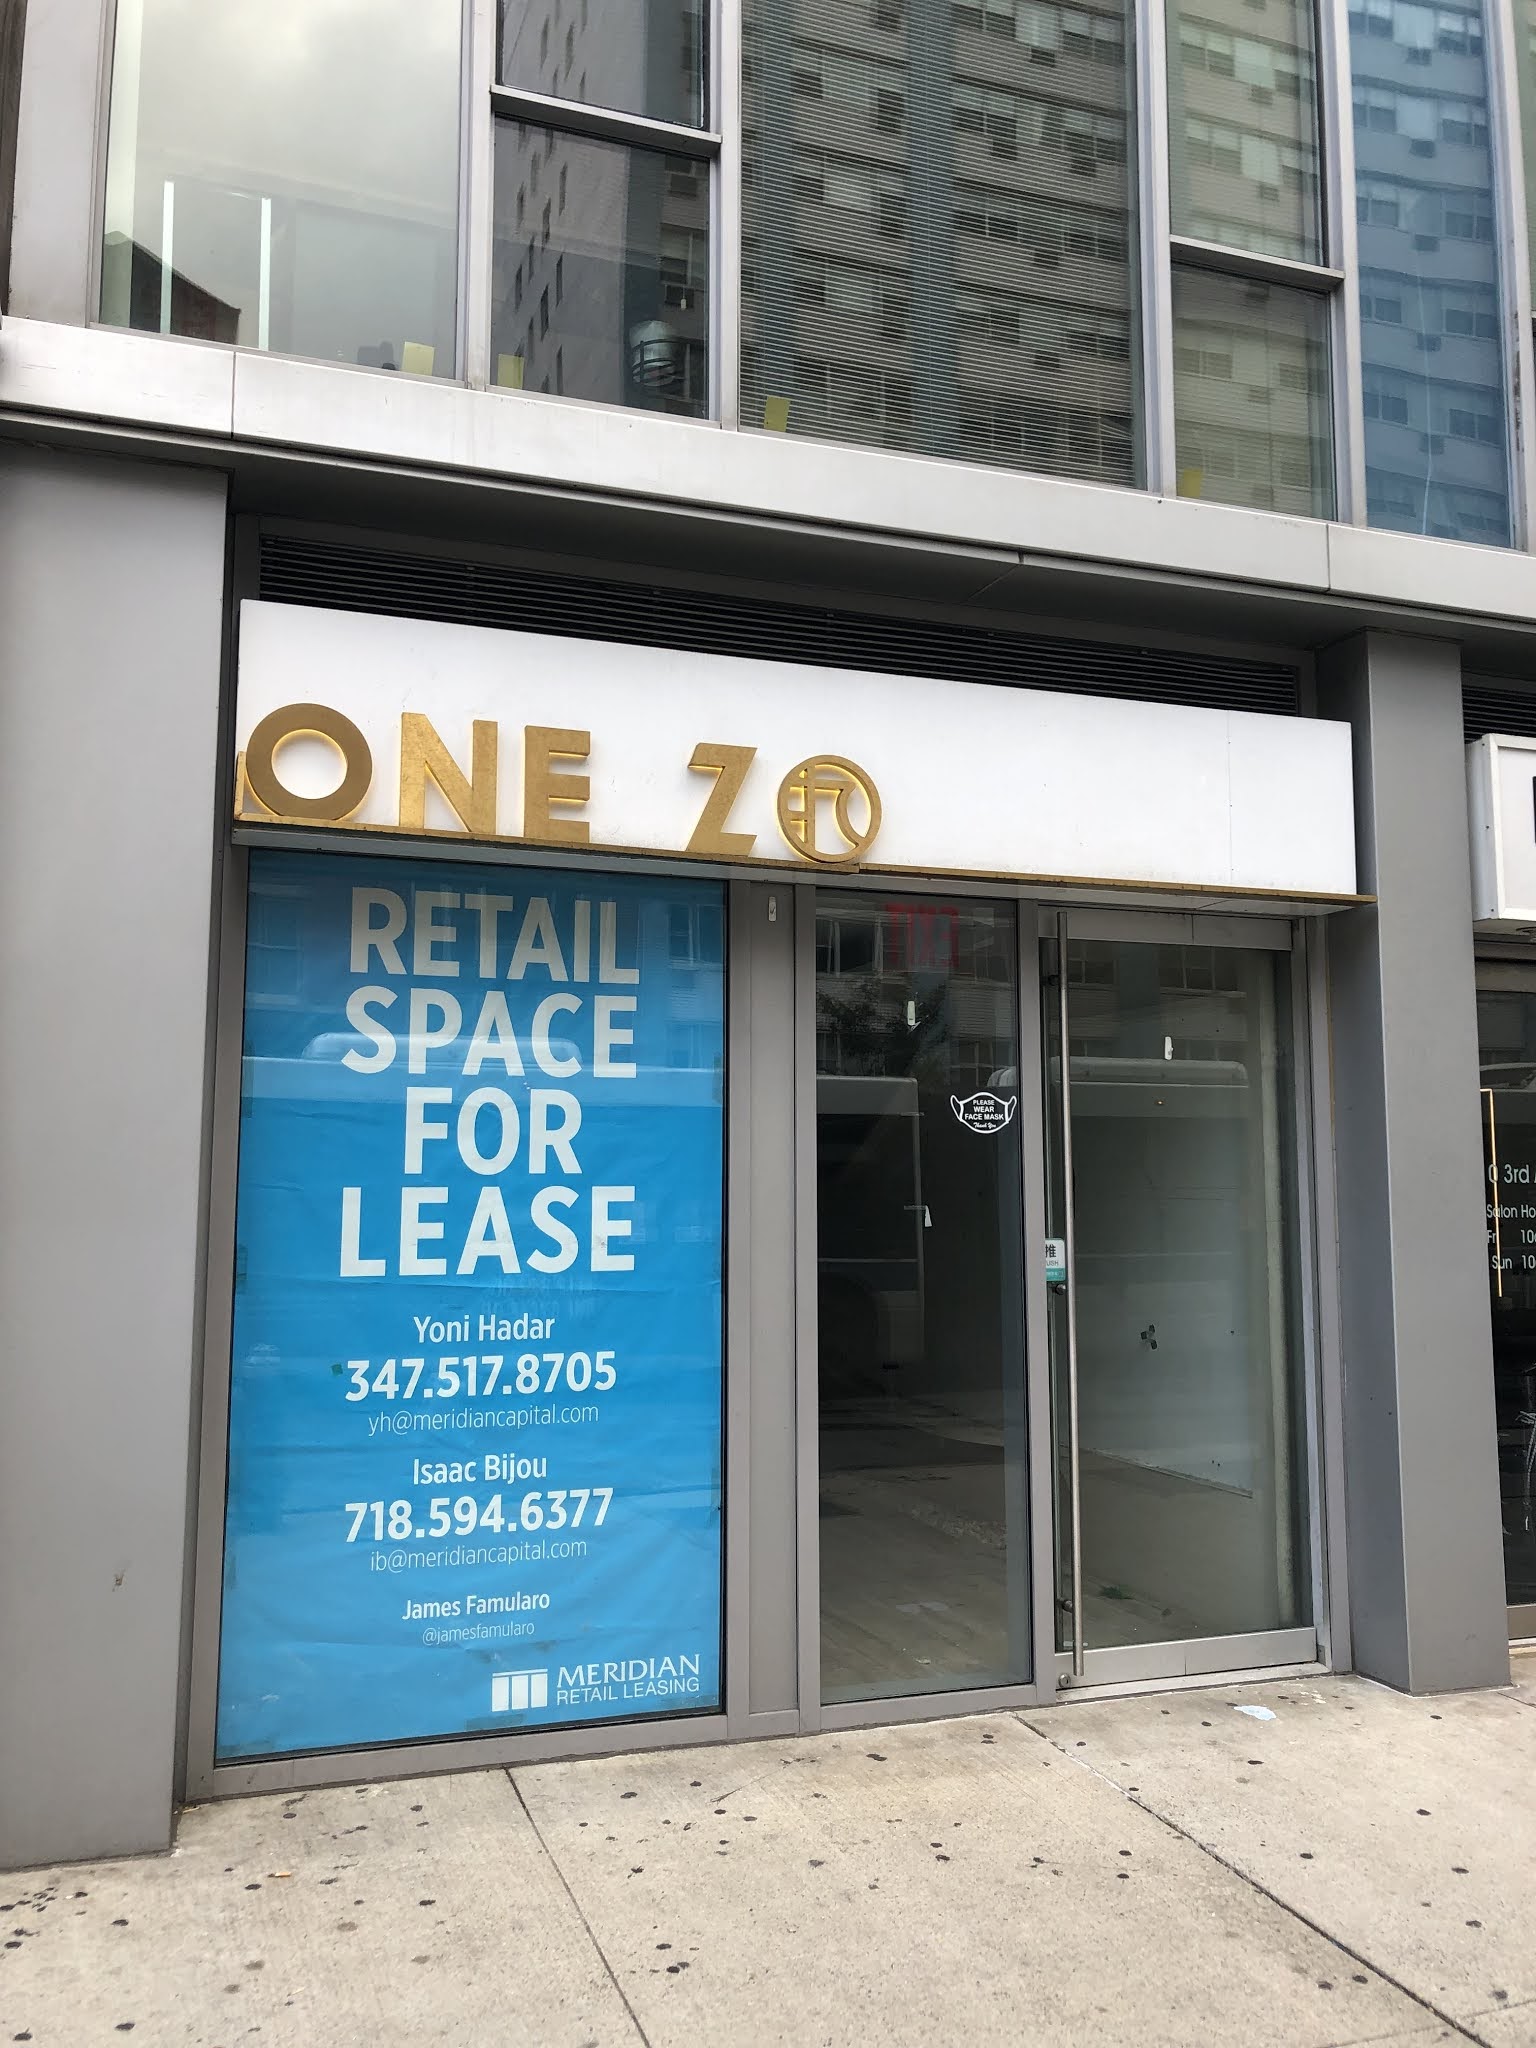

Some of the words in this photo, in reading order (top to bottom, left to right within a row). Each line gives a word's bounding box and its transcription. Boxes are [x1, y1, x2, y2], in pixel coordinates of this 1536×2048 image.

[245, 703, 591, 843] ONE
[350, 886, 640, 985] RETAIL
[341, 985, 638, 1078] SPACE
[404, 1087, 583, 1175] FOR
[1503, 1164, 1530, 1183] 3rd
[1486, 1204, 1518, 1218] Salon
[340, 1186, 636, 1277] LEASE
[1491, 1254, 1513, 1269] Sun
[413, 1315, 470, 1343] Yoni
[478, 1313, 555, 1341] Hadar
[345, 1350, 617, 1402] 347.517.8705
[368, 1404, 599, 1437] yh@meridiancapital.com
[413, 1457, 477, 1485] Isaac
[484, 1453, 548, 1486] Bijou
[345, 1488, 614, 1544] 718.594.6377
[370, 1539, 587, 1573] ib@meridiancapital.com
[401, 1599, 461, 1621] James
[466, 1591, 550, 1615] Famularo
[422, 1621, 535, 1646] @jamesfamularo
[556, 1653, 701, 1687] MERIDIAN
[556, 1684, 619, 1706] RETAIL
[622, 1676, 701, 1700] LEASING
